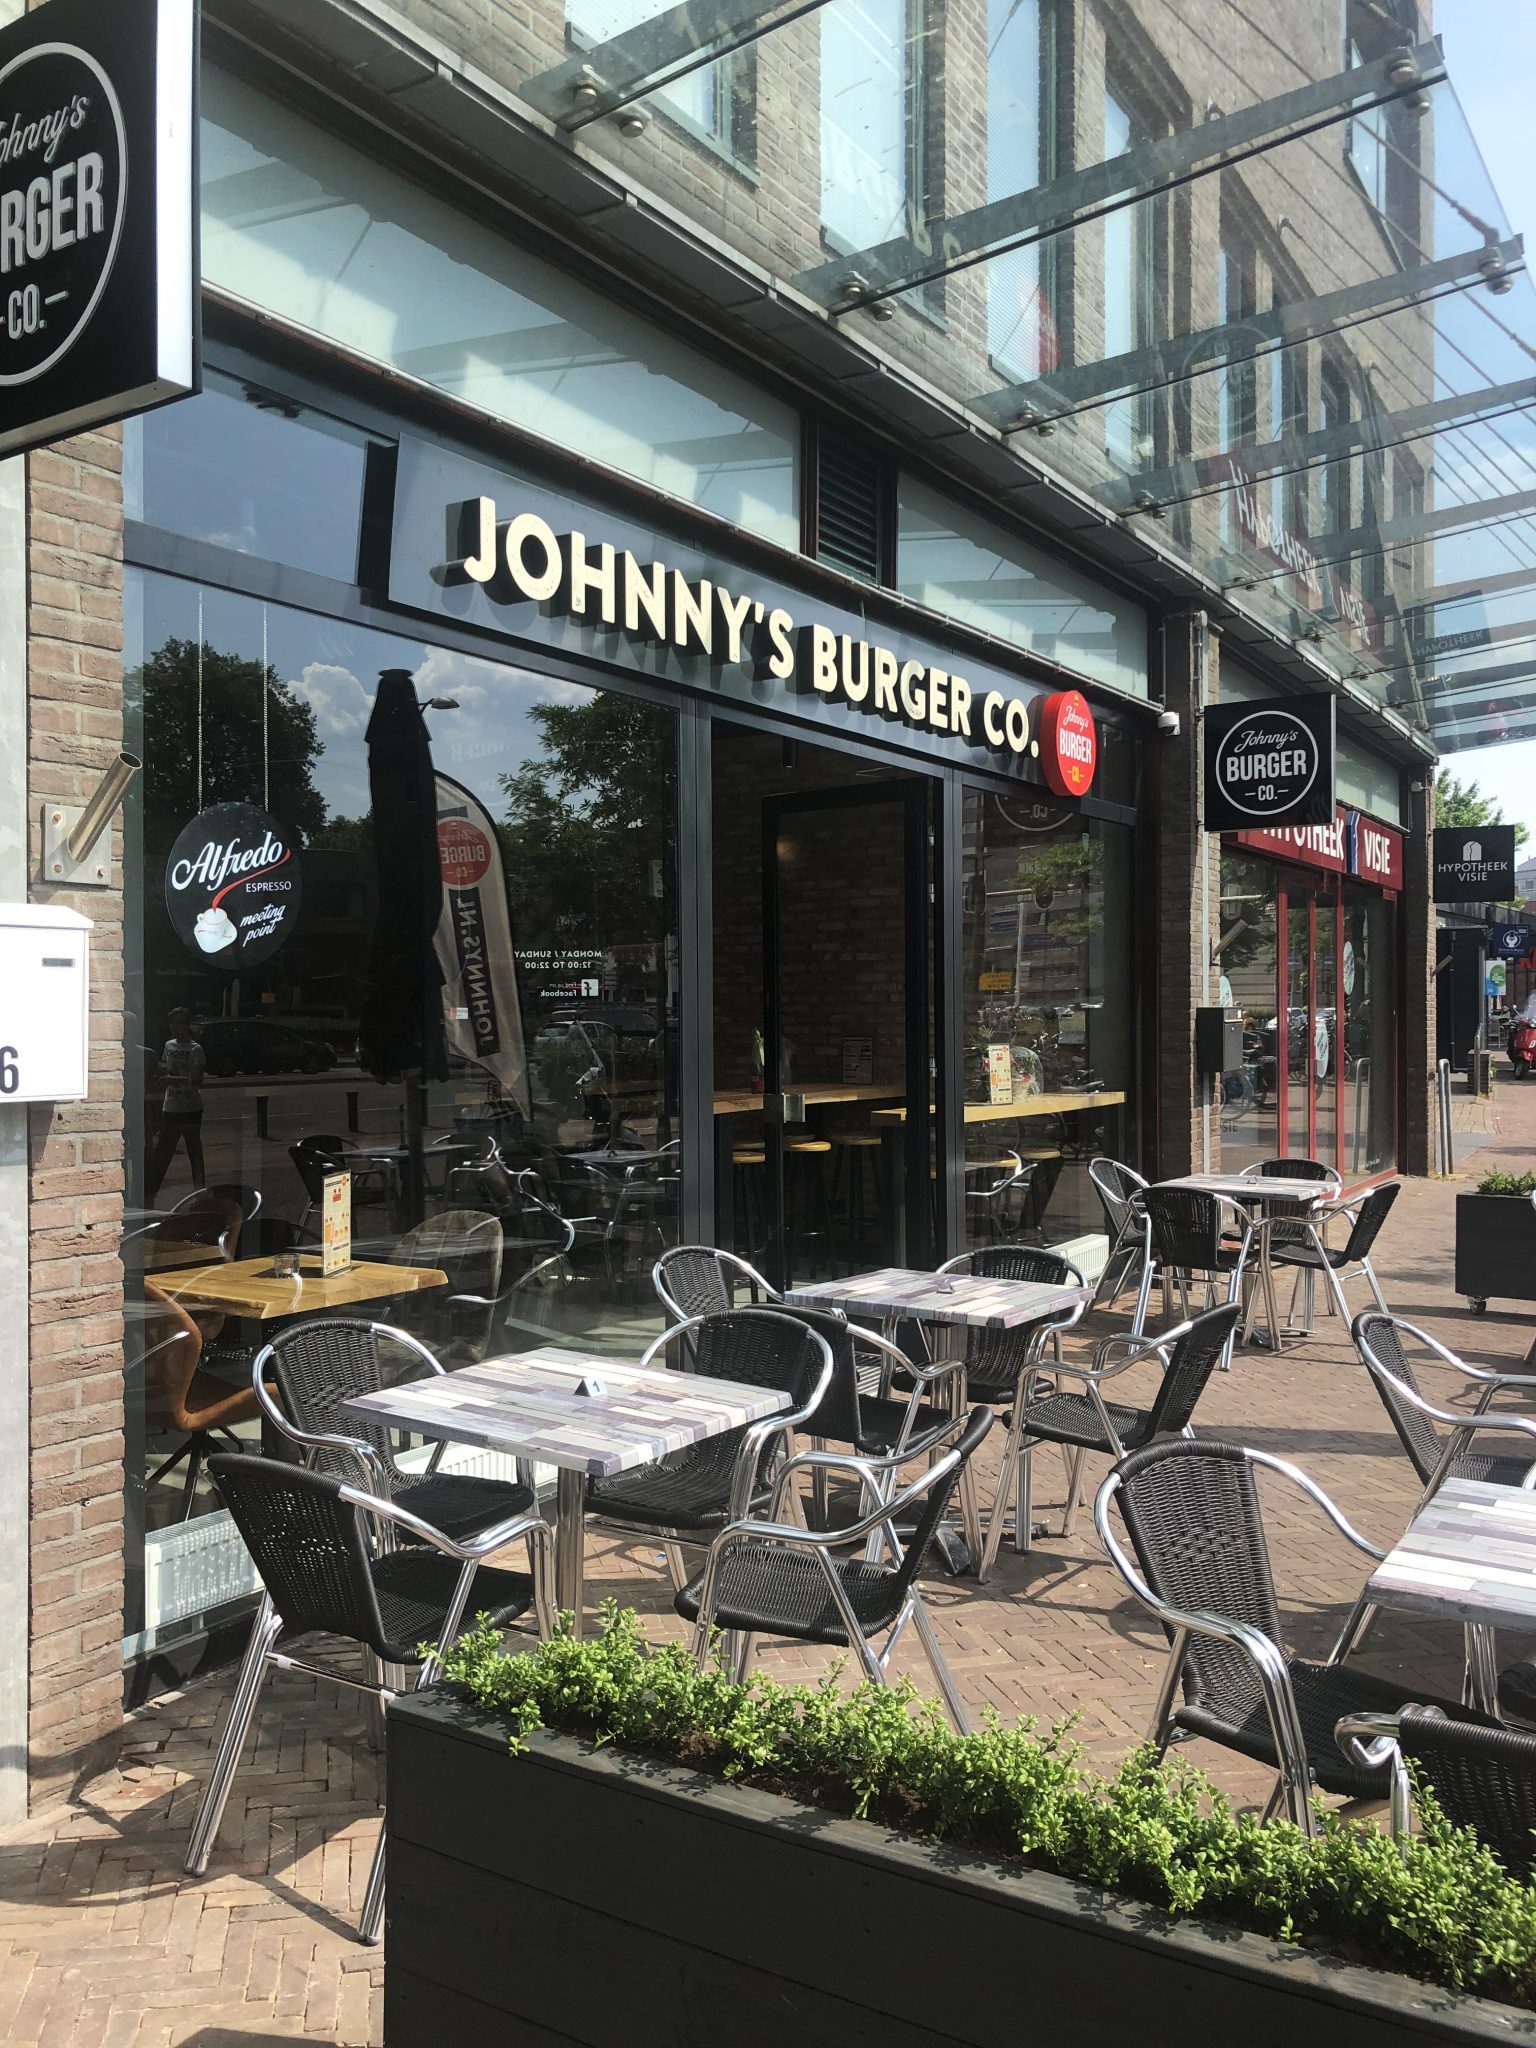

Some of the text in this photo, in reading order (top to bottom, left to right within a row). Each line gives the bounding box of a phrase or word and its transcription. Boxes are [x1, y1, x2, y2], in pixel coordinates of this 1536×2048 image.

[0, 94, 89, 170] ohnny's
[0, 151, 104, 273] RGER
[463, 496, 1039, 758] JOHNNY'S BURGER CO.
[1062, 705, 1090, 733] Johnny's
[1060, 728, 1092, 765] BURGER
[1234, 729, 1299, 754] Johnny's
[1226, 749, 1307, 782] BURGER
[1257, 784, 1278, 801] CO.
[172, 831, 283, 891] Alfredo
[1364, 829, 1391, 875] VISIE
[1438, 862, 1508, 872] HYPOTHEEK
[1458, 872, 1488, 881] VISIE
[246, 881, 291, 892] ESPRESSO
[240, 903, 286, 927] meeting
[242, 919, 277, 947] point
